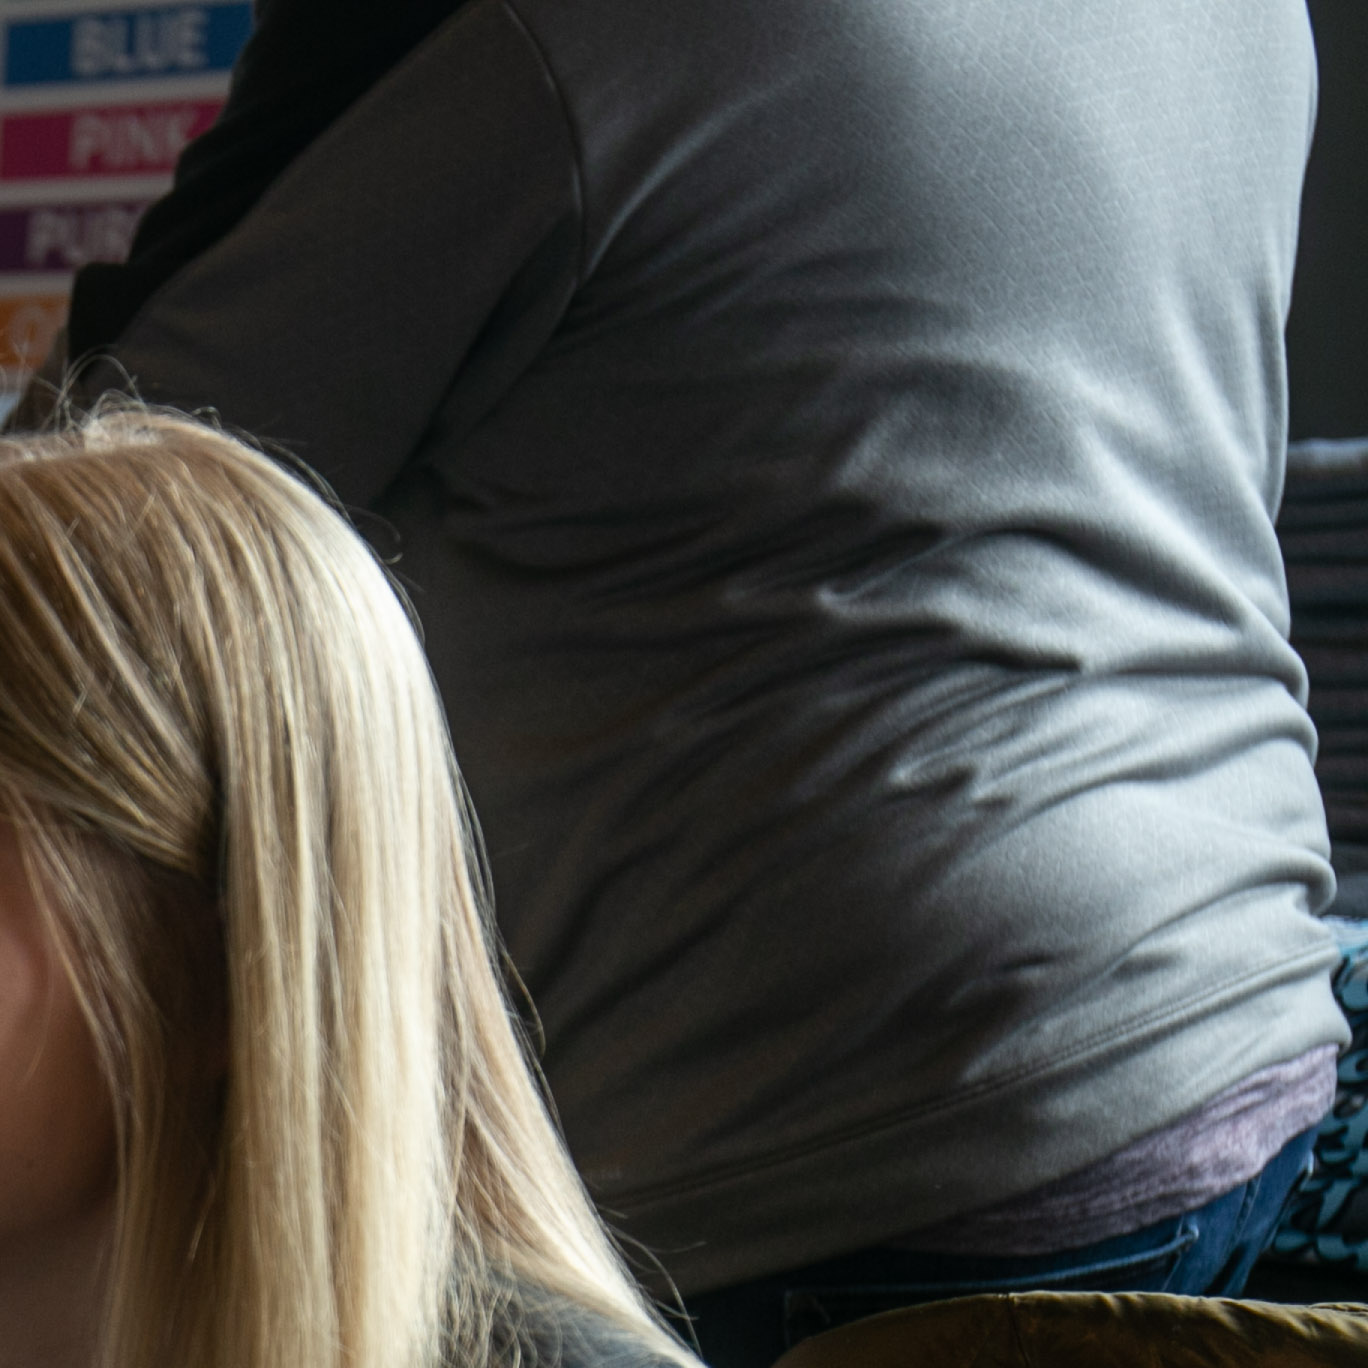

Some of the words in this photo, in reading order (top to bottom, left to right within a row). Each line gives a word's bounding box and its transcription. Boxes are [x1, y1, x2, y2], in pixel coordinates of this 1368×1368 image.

[71, 8, 211, 75] BLUE
[70, 110, 200, 168] PINK
[26, 209, 140, 266] PUR
